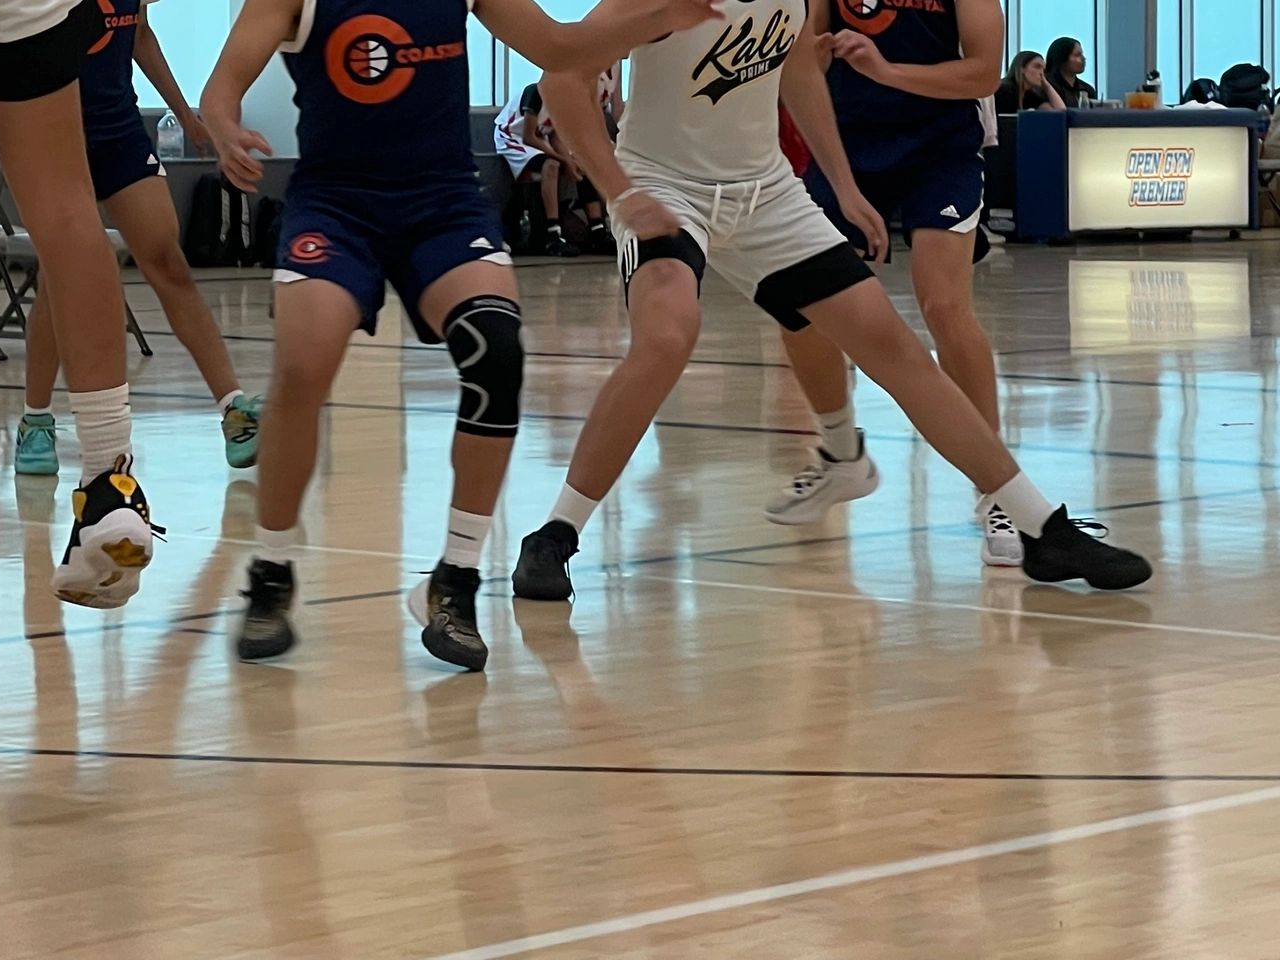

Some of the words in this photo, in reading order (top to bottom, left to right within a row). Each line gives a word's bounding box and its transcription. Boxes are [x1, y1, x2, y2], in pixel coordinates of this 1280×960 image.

[396, 41, 465, 63] COAS
[691, 8, 795, 81] Kali
[740, 60, 770, 82] PRIME
[1127, 152, 1162, 174] OPEN
[1164, 152, 1193, 173] GYM
[1130, 181, 1186, 202] PREMIER
